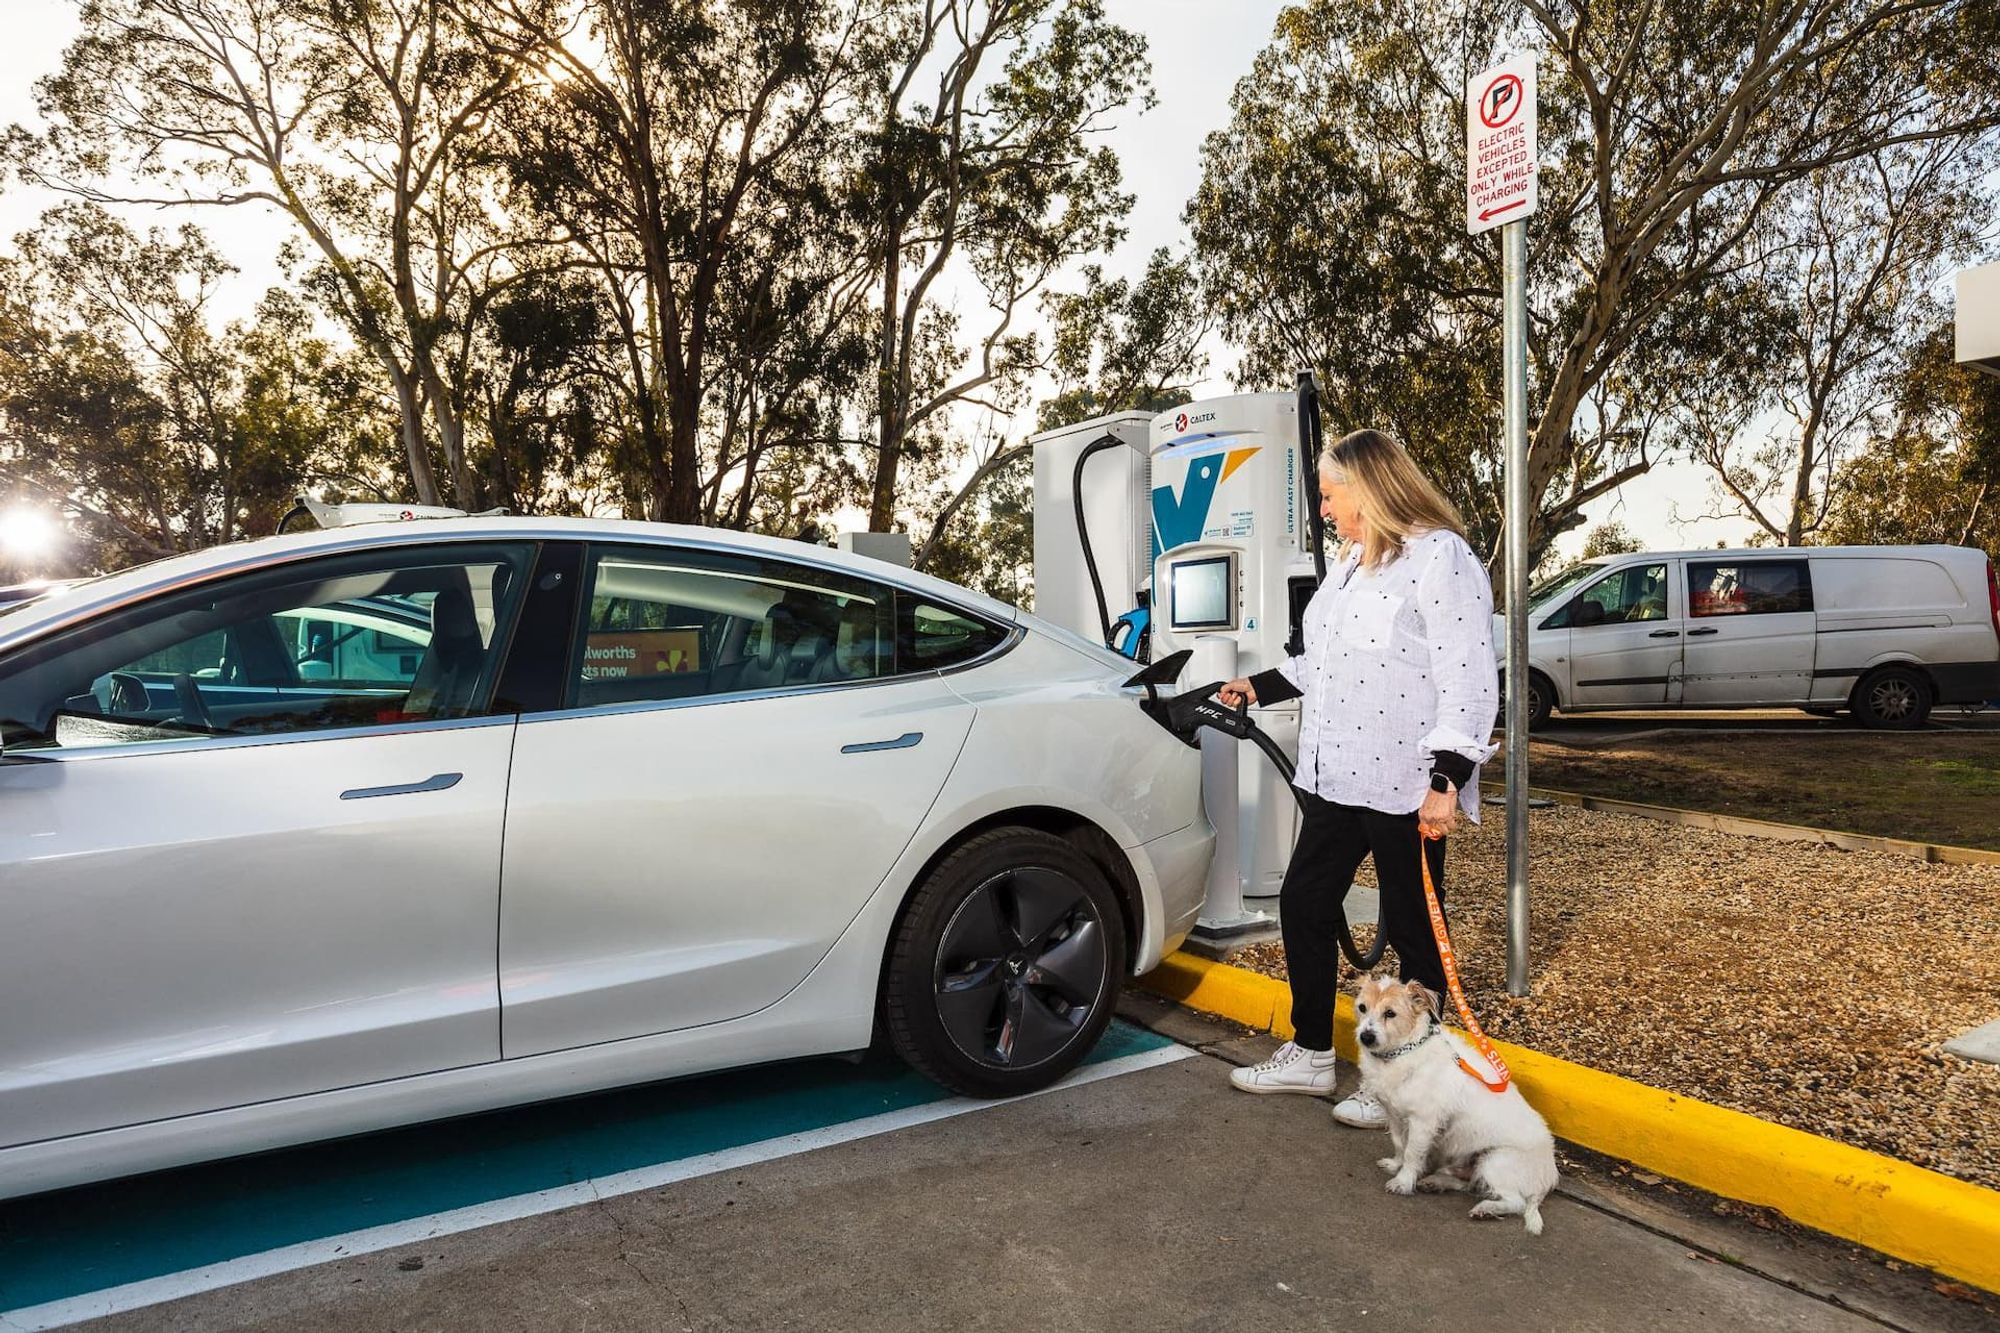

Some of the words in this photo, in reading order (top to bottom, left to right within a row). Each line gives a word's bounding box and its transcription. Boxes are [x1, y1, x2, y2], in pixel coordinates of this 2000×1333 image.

[1478, 122, 1525, 151] ELECTRIC
[1478, 136, 1526, 164] VEHICLES
[1470, 176, 1498, 196] ONLY
[1503, 162, 1534, 183] WHILE
[1476, 151, 1528, 179] EXCEPTED
[1476, 179, 1528, 208] CHARGING
[1190, 412, 1216, 425] CALTEX
[601, 666, 628, 677] now
